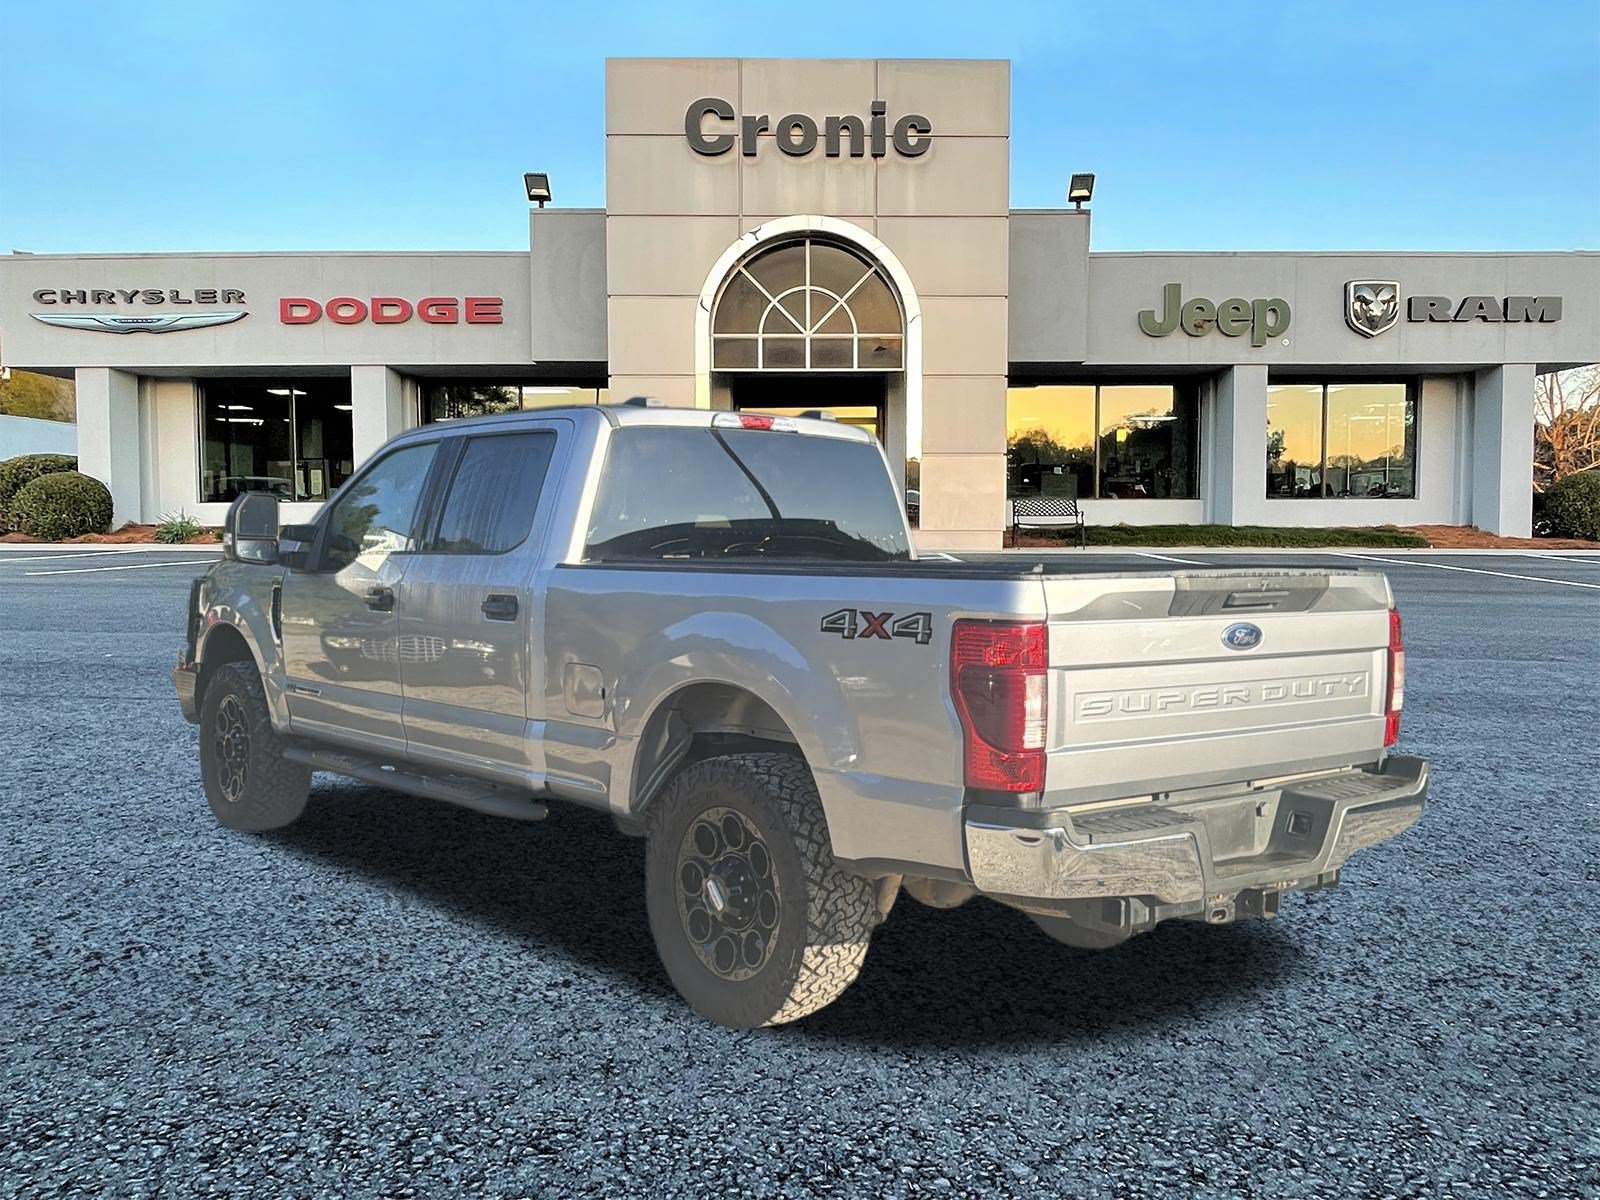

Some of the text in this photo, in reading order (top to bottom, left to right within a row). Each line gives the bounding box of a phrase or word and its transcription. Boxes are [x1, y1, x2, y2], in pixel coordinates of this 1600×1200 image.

[685, 98, 932, 157] Cronic
[33, 288, 246, 305] CHRYSLER
[279, 297, 504, 325] DODGE
[1408, 296, 1563, 322] RAM
[1139, 283, 1291, 347] Jeep
[820, 608, 932, 645] 4X4
[1232, 628, 1258, 645] Ford
[1079, 675, 1364, 717] SUPER DUTY
